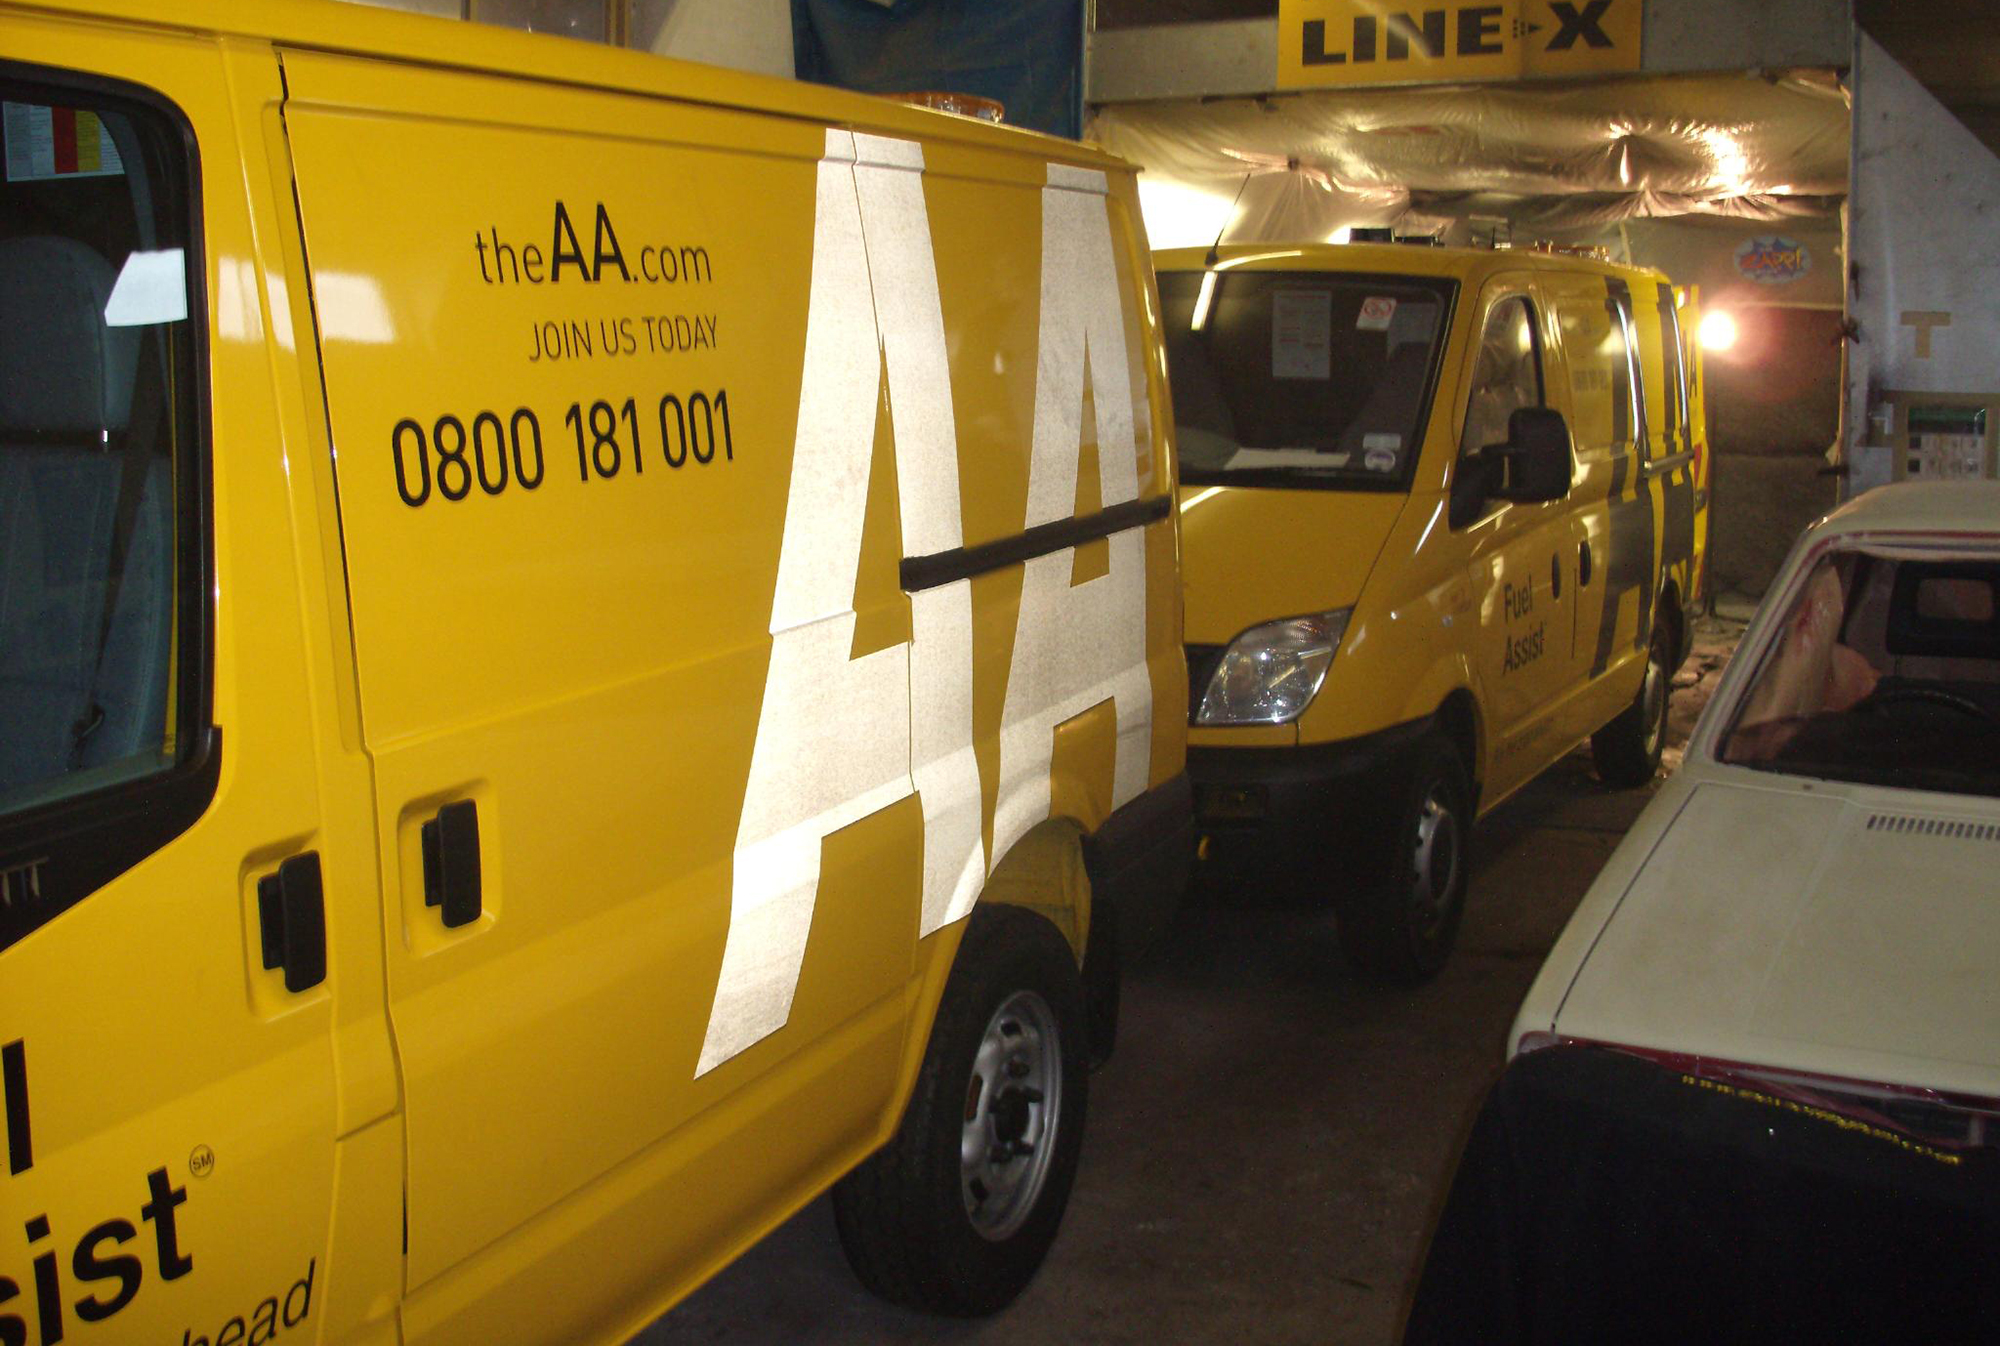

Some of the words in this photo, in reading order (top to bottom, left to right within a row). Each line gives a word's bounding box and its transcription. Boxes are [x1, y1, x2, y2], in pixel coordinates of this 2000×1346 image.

[475, 200, 712, 284] theAA.com
[528, 319, 593, 362] JOIN
[600, 318, 638, 355] US
[642, 315, 718, 353] TODAY
[391, 406, 545, 507] 0800
[565, 397, 643, 483] 181
[659, 388, 733, 469] 001
[694, 128, 1153, 1080] AA
[1504, 572, 1532, 625] Fuel
[1502, 621, 1545, 675] Assist
